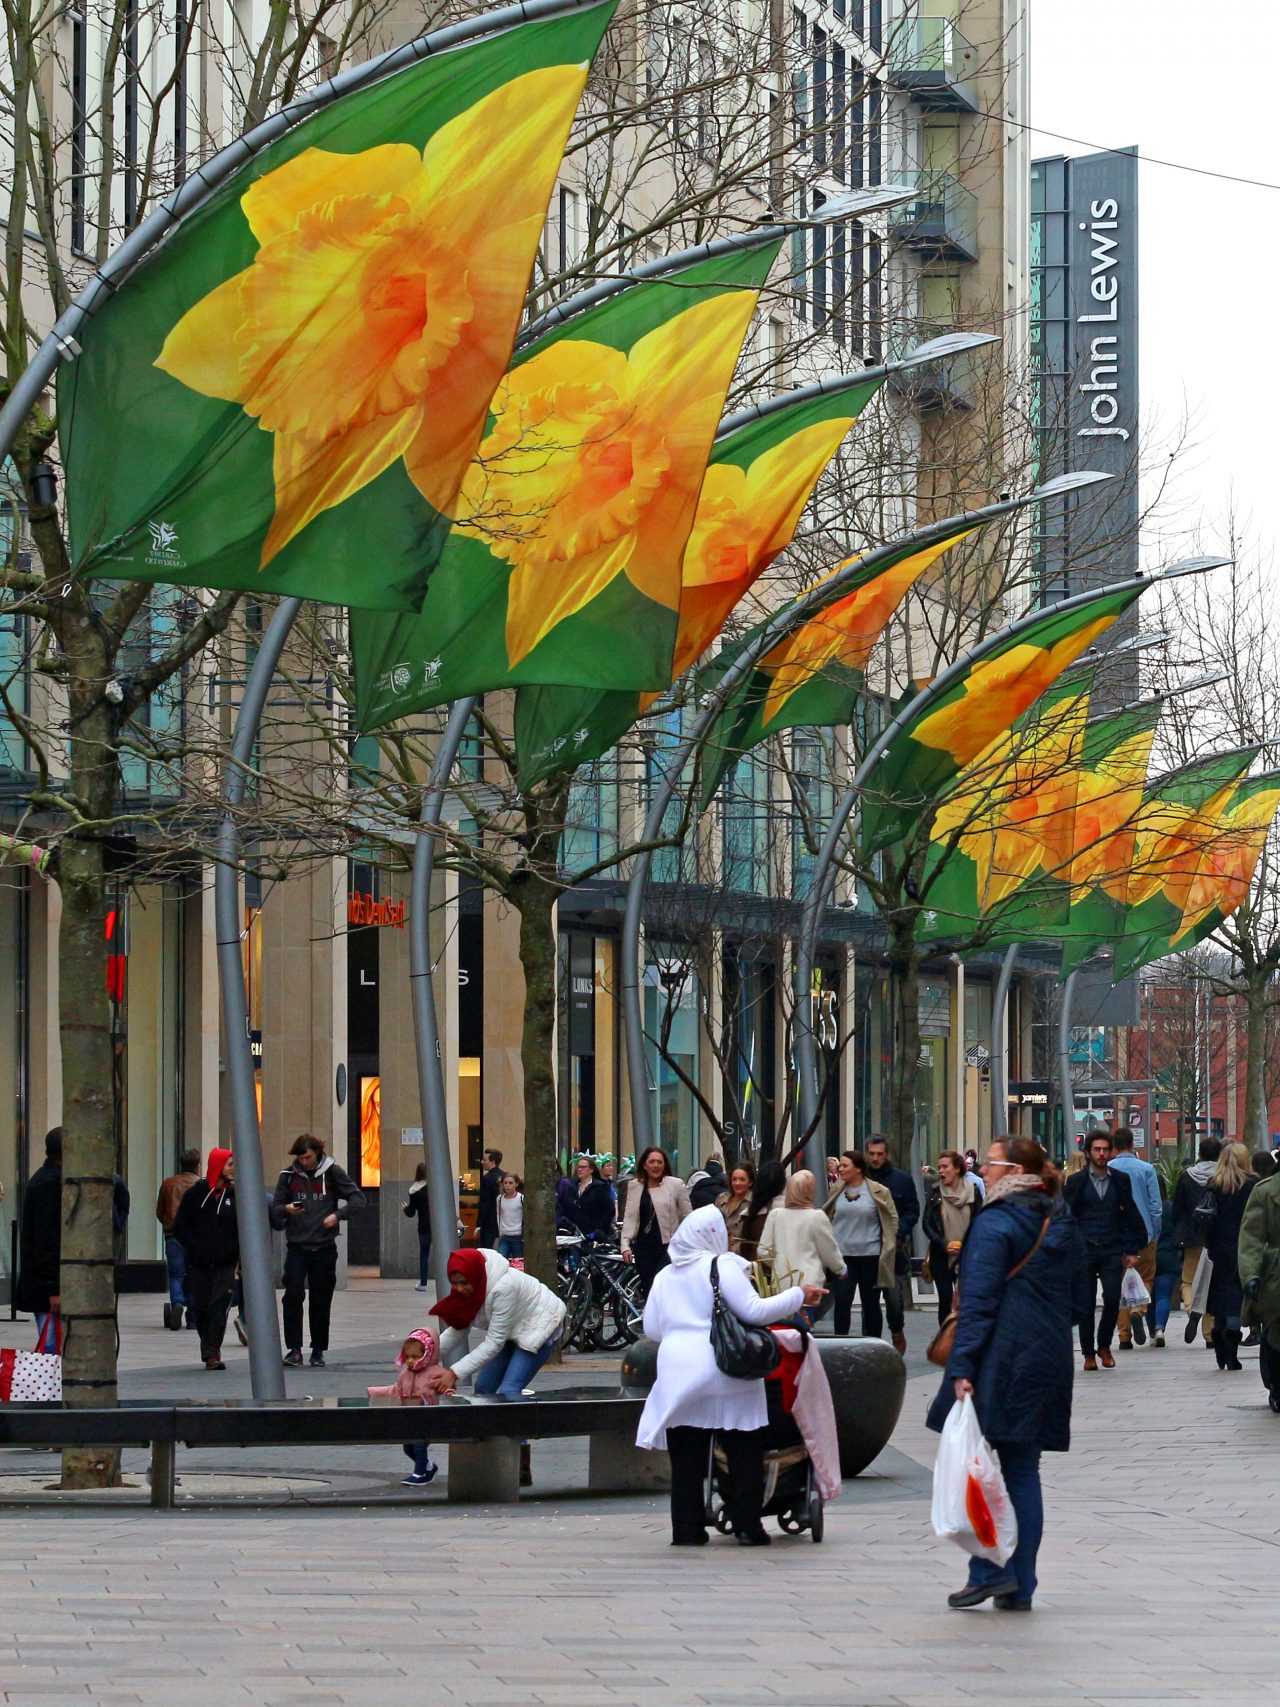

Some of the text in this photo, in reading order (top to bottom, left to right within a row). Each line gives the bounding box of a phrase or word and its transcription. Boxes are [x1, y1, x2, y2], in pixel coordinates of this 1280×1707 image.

[1076, 198, 1129, 442] John Lewis
[573, 976, 593, 994] LINKS
